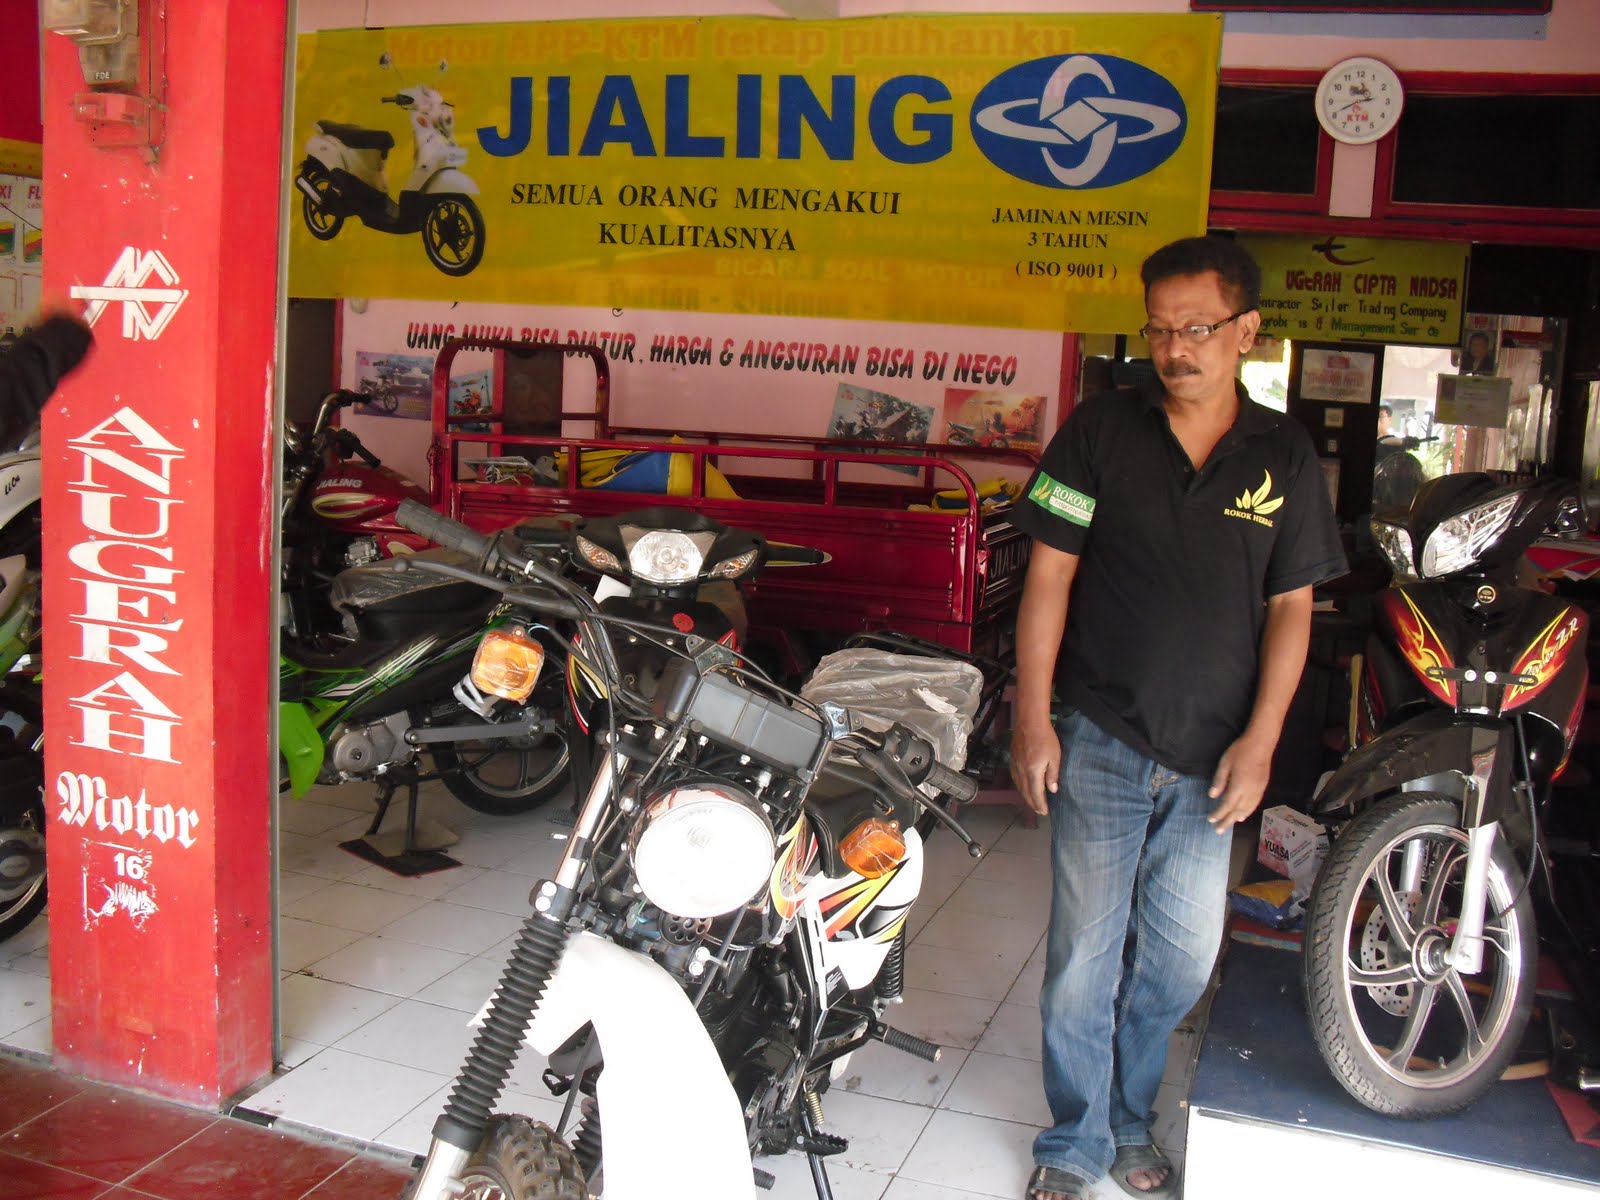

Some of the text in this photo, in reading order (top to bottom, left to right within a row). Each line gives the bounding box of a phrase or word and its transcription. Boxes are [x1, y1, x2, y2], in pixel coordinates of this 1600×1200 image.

[713, 23, 827, 64] tetap
[1356, 70, 1366, 78] 12
[1334, 83, 1342, 91] 10
[1381, 83, 1387, 91] 2
[1385, 98, 1391, 106] 3
[476, 74, 954, 165] JIALING
[510, 183, 902, 215] SEMUA ORANG MENGAKUI
[991, 207, 1149, 228] JAMINAN MESIN
[598, 222, 797, 252] KUALITASNYA
[1027, 231, 1109, 249] 3 TAHUN
[1028, 261, 1061, 277] ISO
[1067, 263, 1104, 279] 9001
[1353, 273, 1396, 296] CIPTA
[1259, 299, 1303, 311] ntractor
[1400, 303, 1448, 322] Company
[1331, 317, 1395, 337] Management
[406, 321, 455, 351] UANG
[649, 334, 713, 368] HARGA
[718, 337, 734, 364] &
[740, 339, 861, 376] ANGSURAN
[865, 346, 915, 379] BISA
[922, 349, 948, 381] DI
[953, 352, 1019, 387] NEGO
[1053, 486, 1091, 511] ROKOK
[1223, 508, 1252, 520] ROKOK
[990, 537, 1032, 579] JIALIN
[67, 405, 186, 765] ANUGERAH
[57, 770, 200, 850] Motor
[1264, 838, 1290, 861] YUASA
[114, 852, 144, 880] 16
